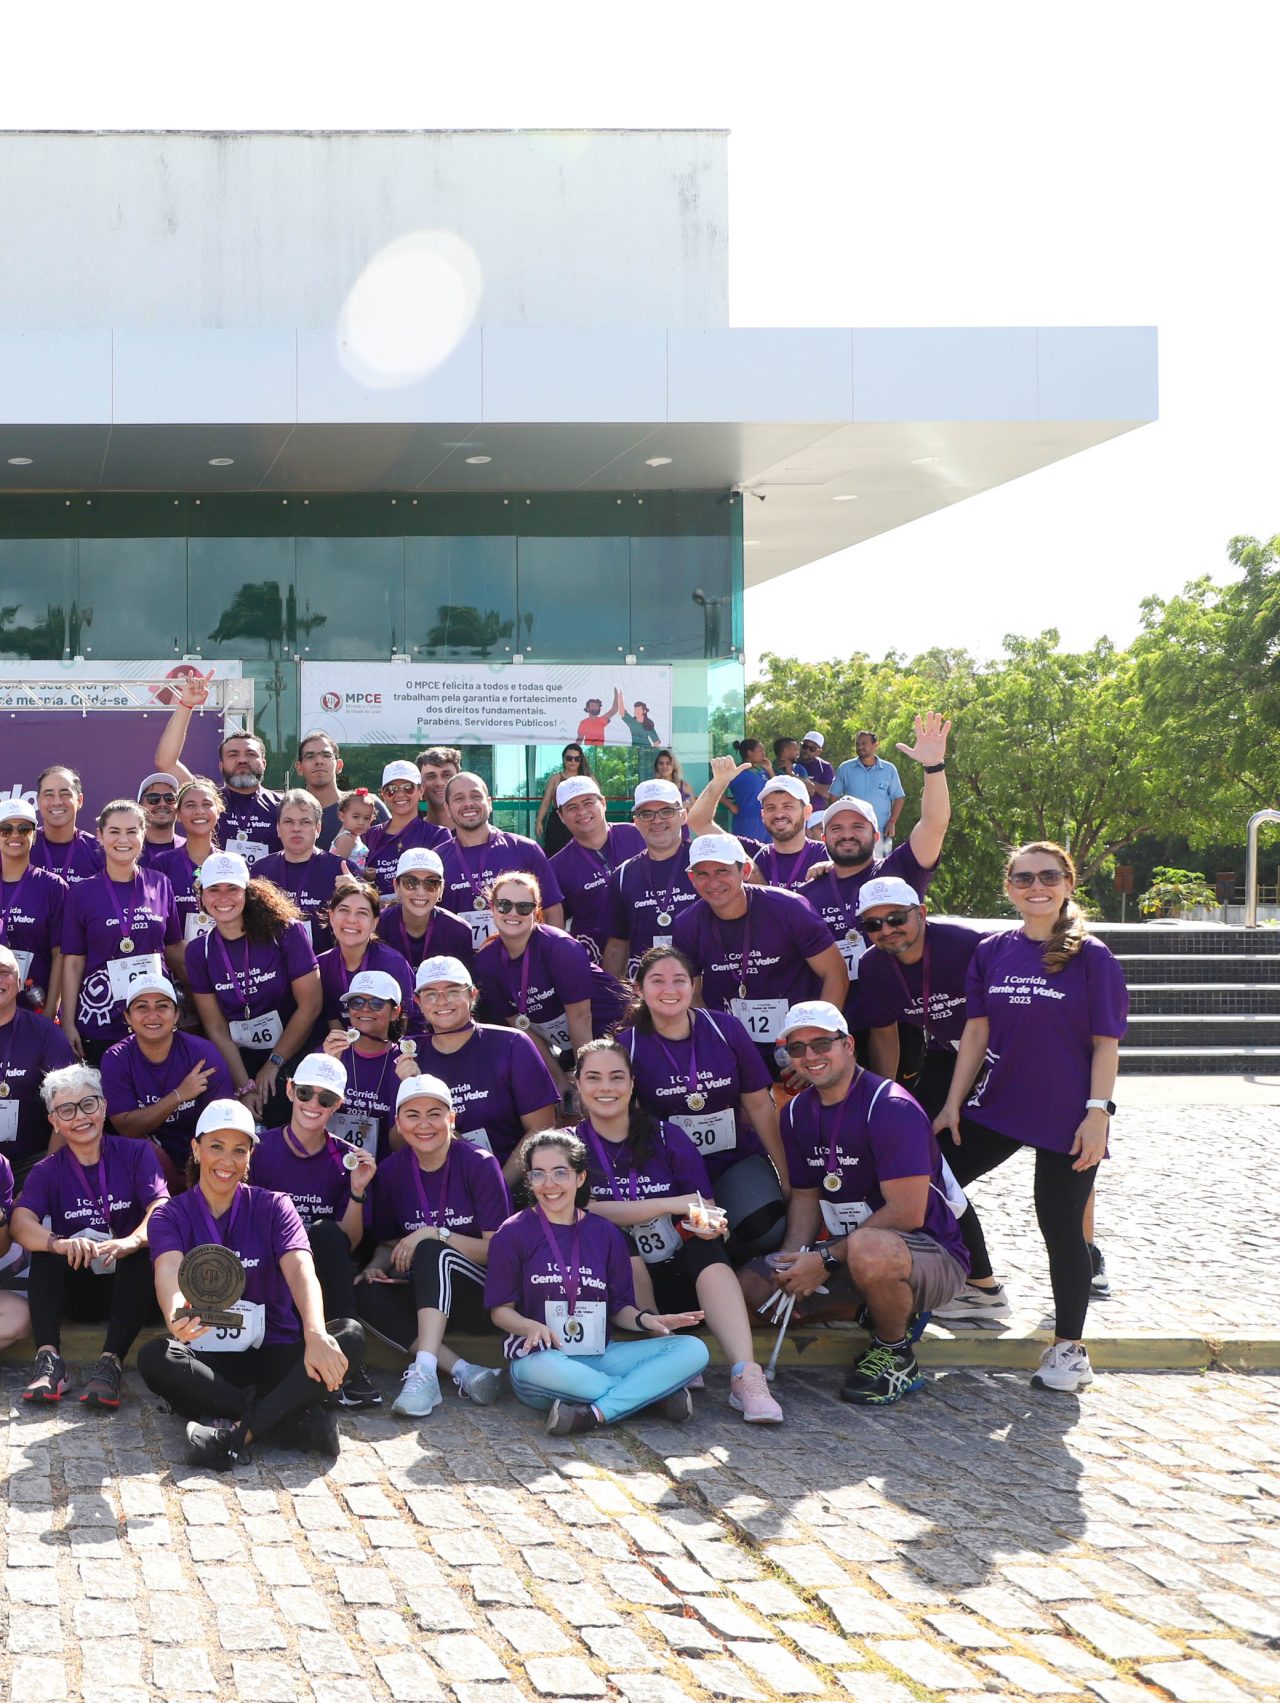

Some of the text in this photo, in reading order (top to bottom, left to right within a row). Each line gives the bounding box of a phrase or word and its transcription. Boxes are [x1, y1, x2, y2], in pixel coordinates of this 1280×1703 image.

[406, 681, 413, 689] O
[414, 681, 440, 689] MPCE
[442, 681, 474, 690] felicita
[483, 682, 509, 690] todos
[518, 683, 544, 691] todas
[545, 684, 563, 692] que
[345, 693, 382, 703] MPCE
[393, 693, 440, 701] trabalham
[441, 694, 461, 703] pela
[462, 694, 500, 703] garantia
[510, 695, 578, 703] fortalecimento
[426, 705, 547, 714] dos direitos fundamentais.
[417, 717, 558, 727] Parabéns, Servidores Públicos!
[241, 853, 256, 863] 0
[450, 881, 471, 891] Gent
[672, 894, 697, 902] Valor
[656, 905, 675, 913] 23
[13, 915, 36, 923] Valor
[131, 922, 149, 930] 2023
[472, 924, 489, 940] 71
[729, 950, 761, 960] Coda
[711, 956, 780, 972] Gente Valor
[737, 967, 759, 976] 223
[214, 971, 277, 991] Gen Valor
[1004, 975, 1047, 985] I Corrida
[534, 987, 555, 1001] Valor
[1016, 985, 1030, 994] de
[1033, 987, 1066, 1000] Valor
[917, 993, 950, 1005] Crrida
[931, 997, 967, 1011] de Valo
[1009, 995, 1032, 1004] 2023
[930, 1008, 953, 1020] 2023
[748, 1015, 770, 1033] 12
[252, 1029, 272, 1043] 46
[550, 1030, 570, 1044] 18
[450, 1083, 471, 1094] rrida
[656, 1077, 732, 1096] Gente Valor
[346, 1088, 379, 1100] Corrida
[464, 1090, 489, 1101] Valor
[176, 1100, 196, 1112] alor
[354, 1099, 366, 1107] de
[347, 1108, 367, 1117] 2023
[452, 1105, 466, 1114] 023
[344, 1130, 363, 1147] 48
[692, 1130, 716, 1147] 30
[837, 1156, 860, 1166] Valor
[643, 1182, 671, 1194] Valor
[64, 1207, 93, 1219] Gente
[90, 1217, 106, 1226] 202
[446, 1216, 474, 1227] Valor
[638, 1232, 665, 1254] 83
[554, 1264, 592, 1275] Crda
[531, 1275, 607, 1290] Gente Valor
